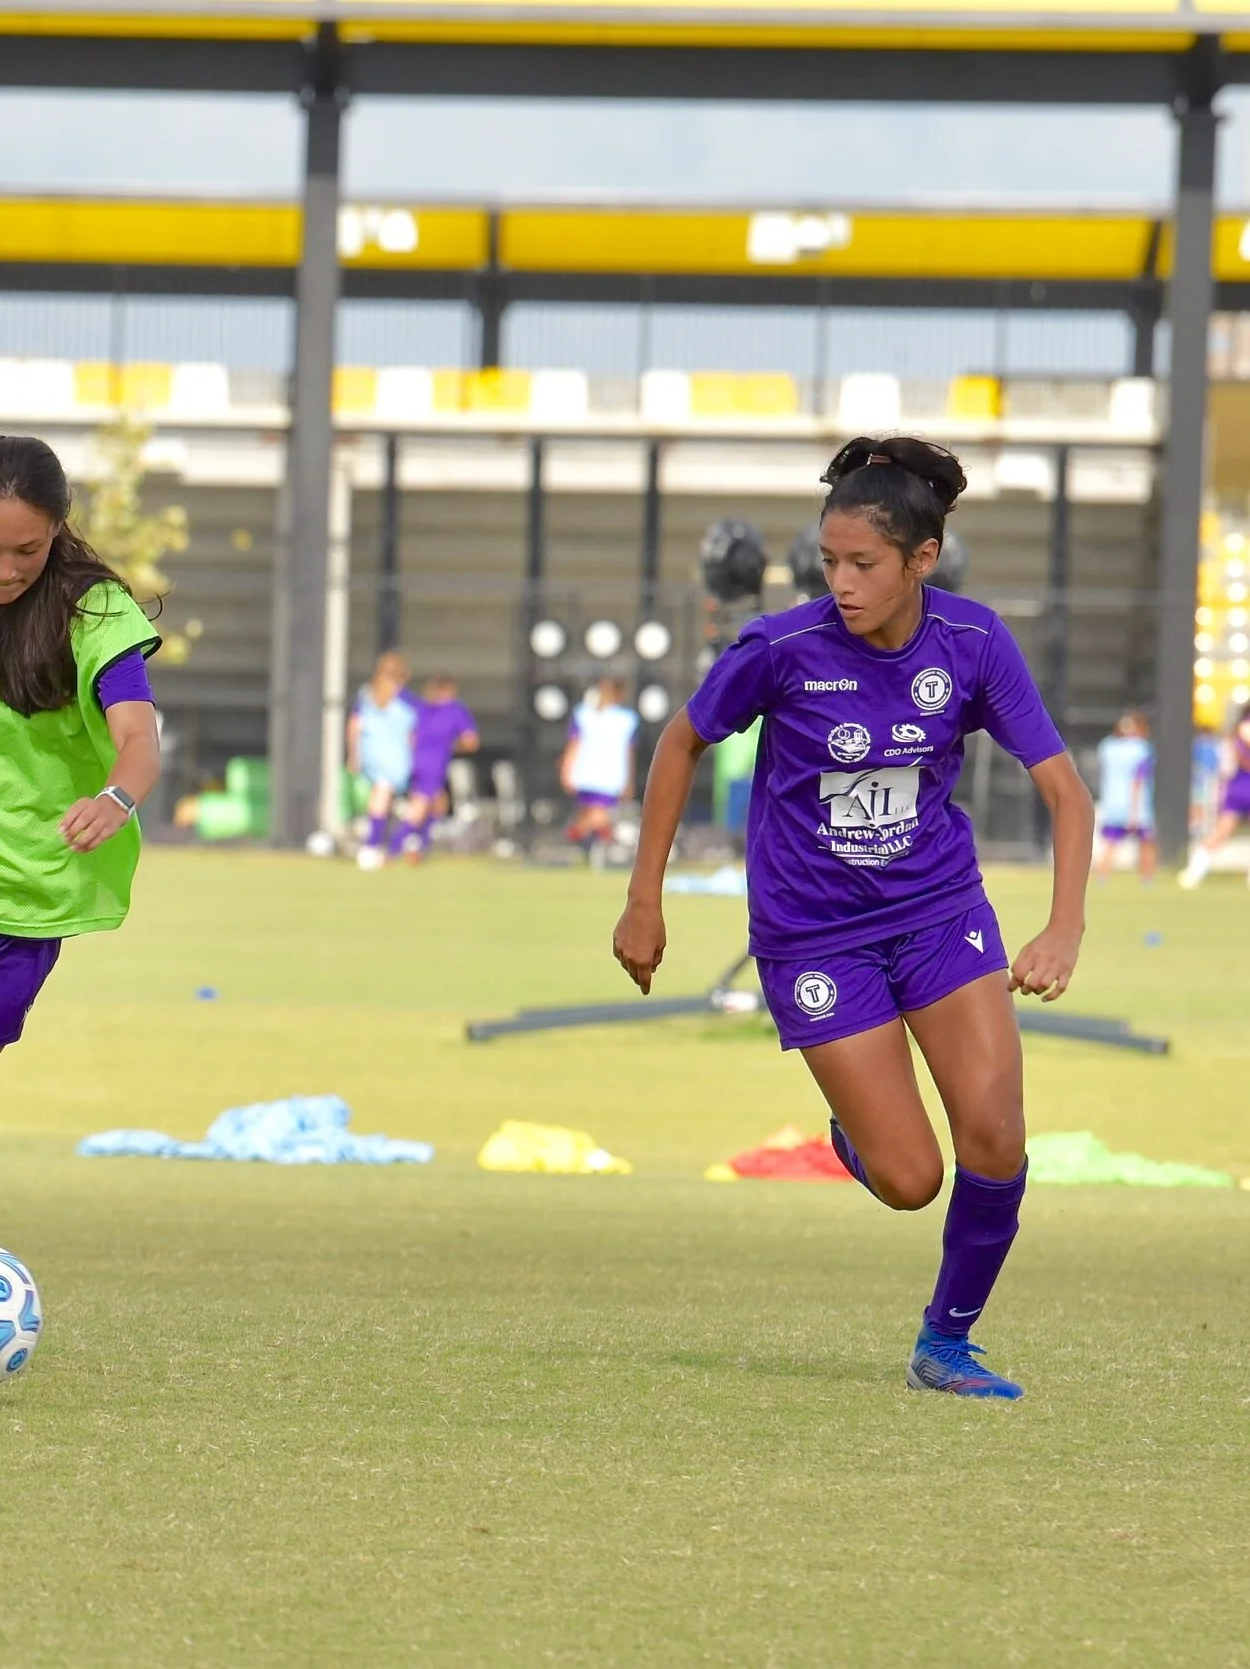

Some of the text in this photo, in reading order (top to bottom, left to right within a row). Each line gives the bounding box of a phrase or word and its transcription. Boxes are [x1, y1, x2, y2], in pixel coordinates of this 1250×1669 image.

[804, 678, 858, 692] macron
[924, 680, 939, 699] T
[883, 745, 934, 757] CDO Advisors
[830, 835, 914, 855] Industrial LLC
[804, 983, 821, 1004] T
